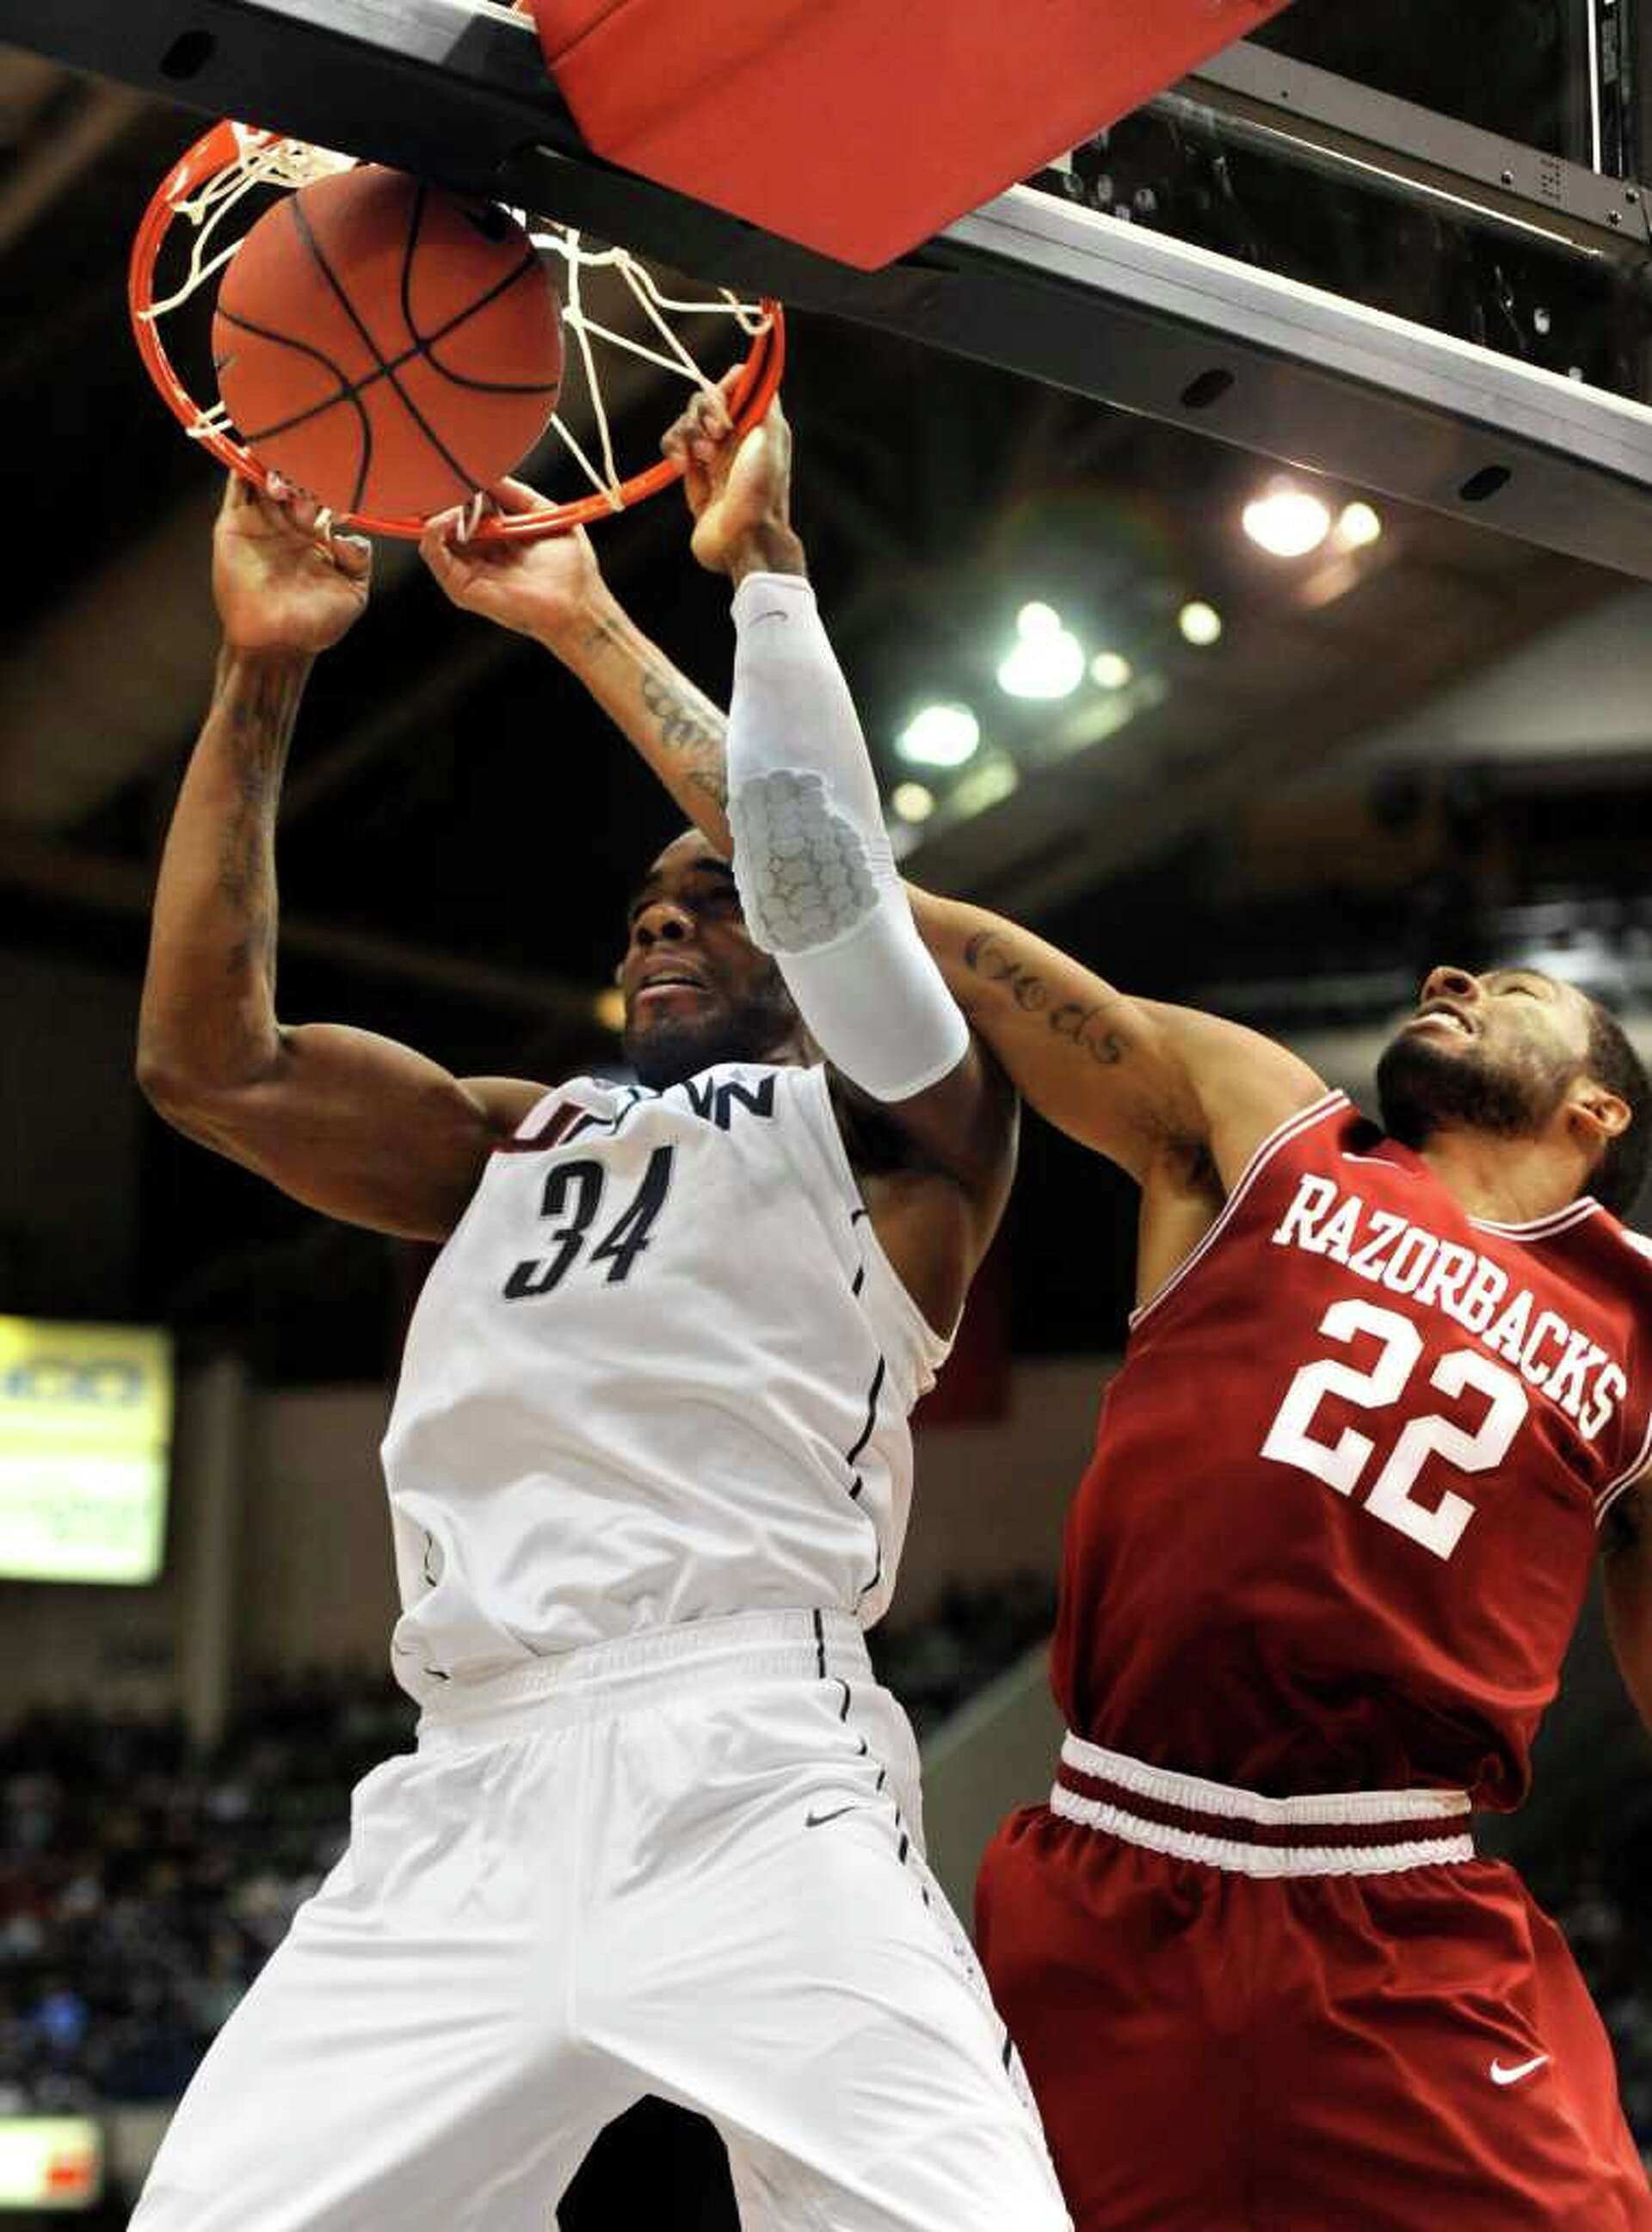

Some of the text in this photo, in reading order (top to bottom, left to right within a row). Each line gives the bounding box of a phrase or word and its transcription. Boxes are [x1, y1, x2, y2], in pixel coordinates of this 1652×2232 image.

[503, 1144, 675, 1302] 34
[1272, 1172, 1628, 1441] RAZORBACKS
[1260, 1298, 1529, 1562] 22
